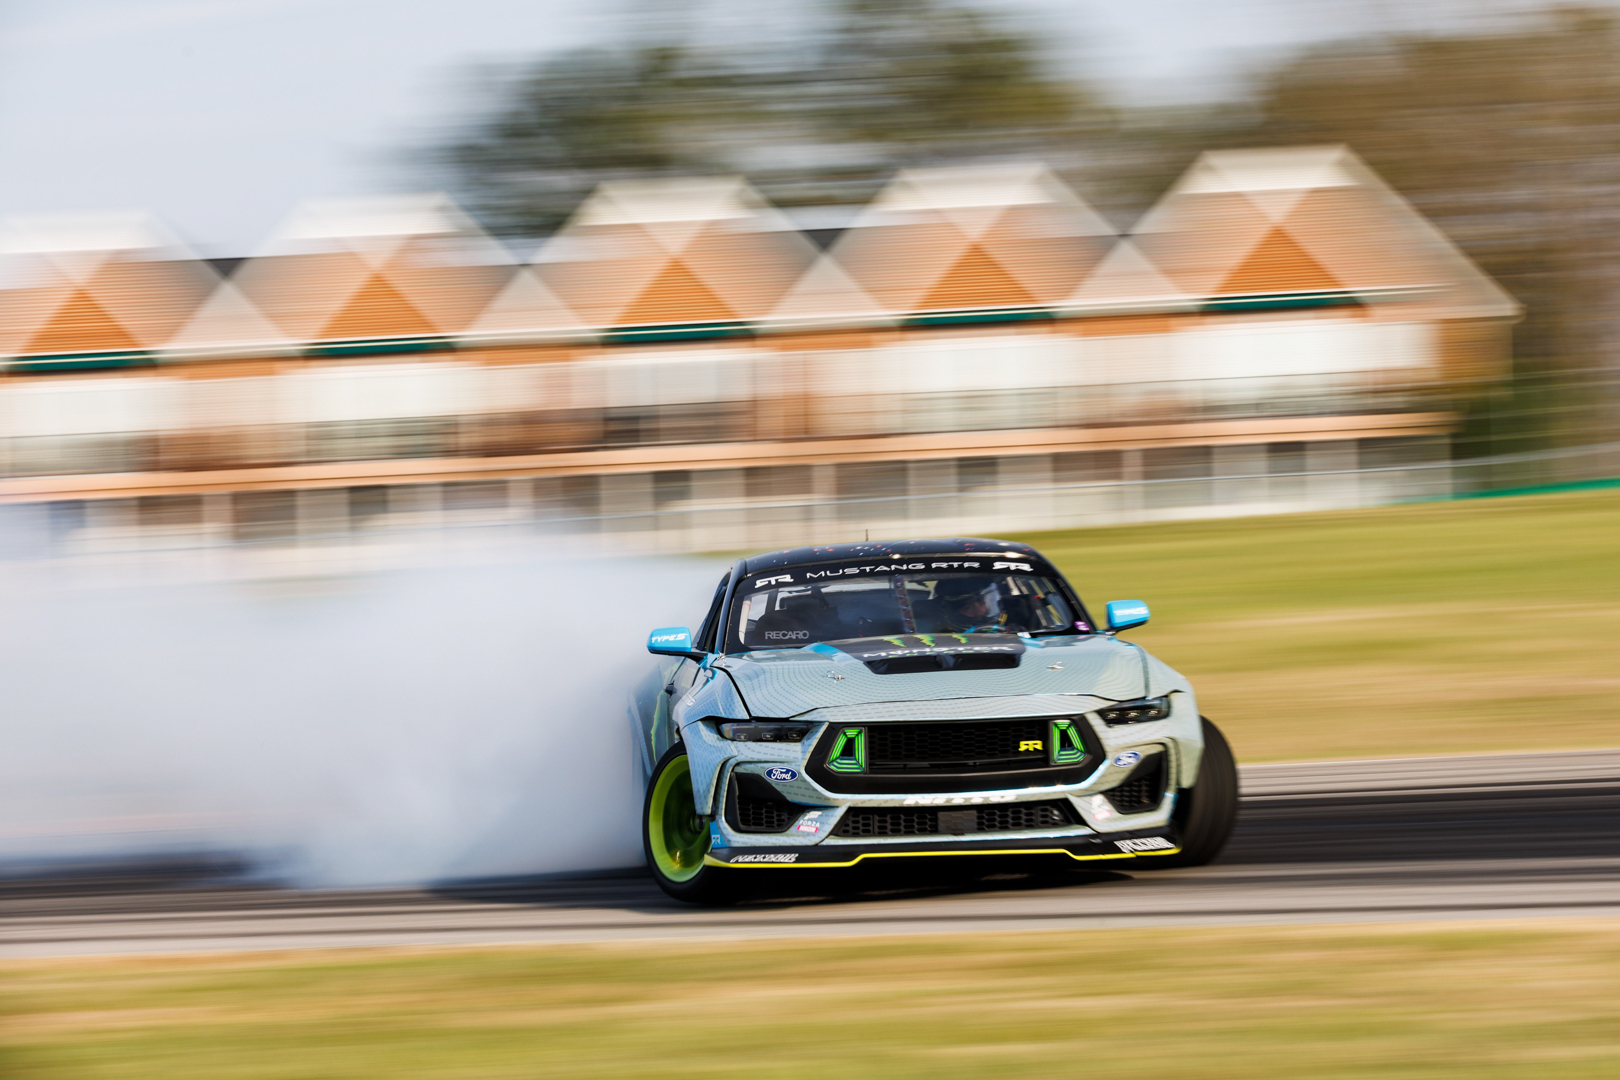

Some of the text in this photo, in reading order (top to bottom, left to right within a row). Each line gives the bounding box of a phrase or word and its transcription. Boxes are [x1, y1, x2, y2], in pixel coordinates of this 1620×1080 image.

[806, 561, 981, 579] MUSTANG RTR
[765, 630, 810, 640] RECARO
[771, 768, 793, 780] Ford
